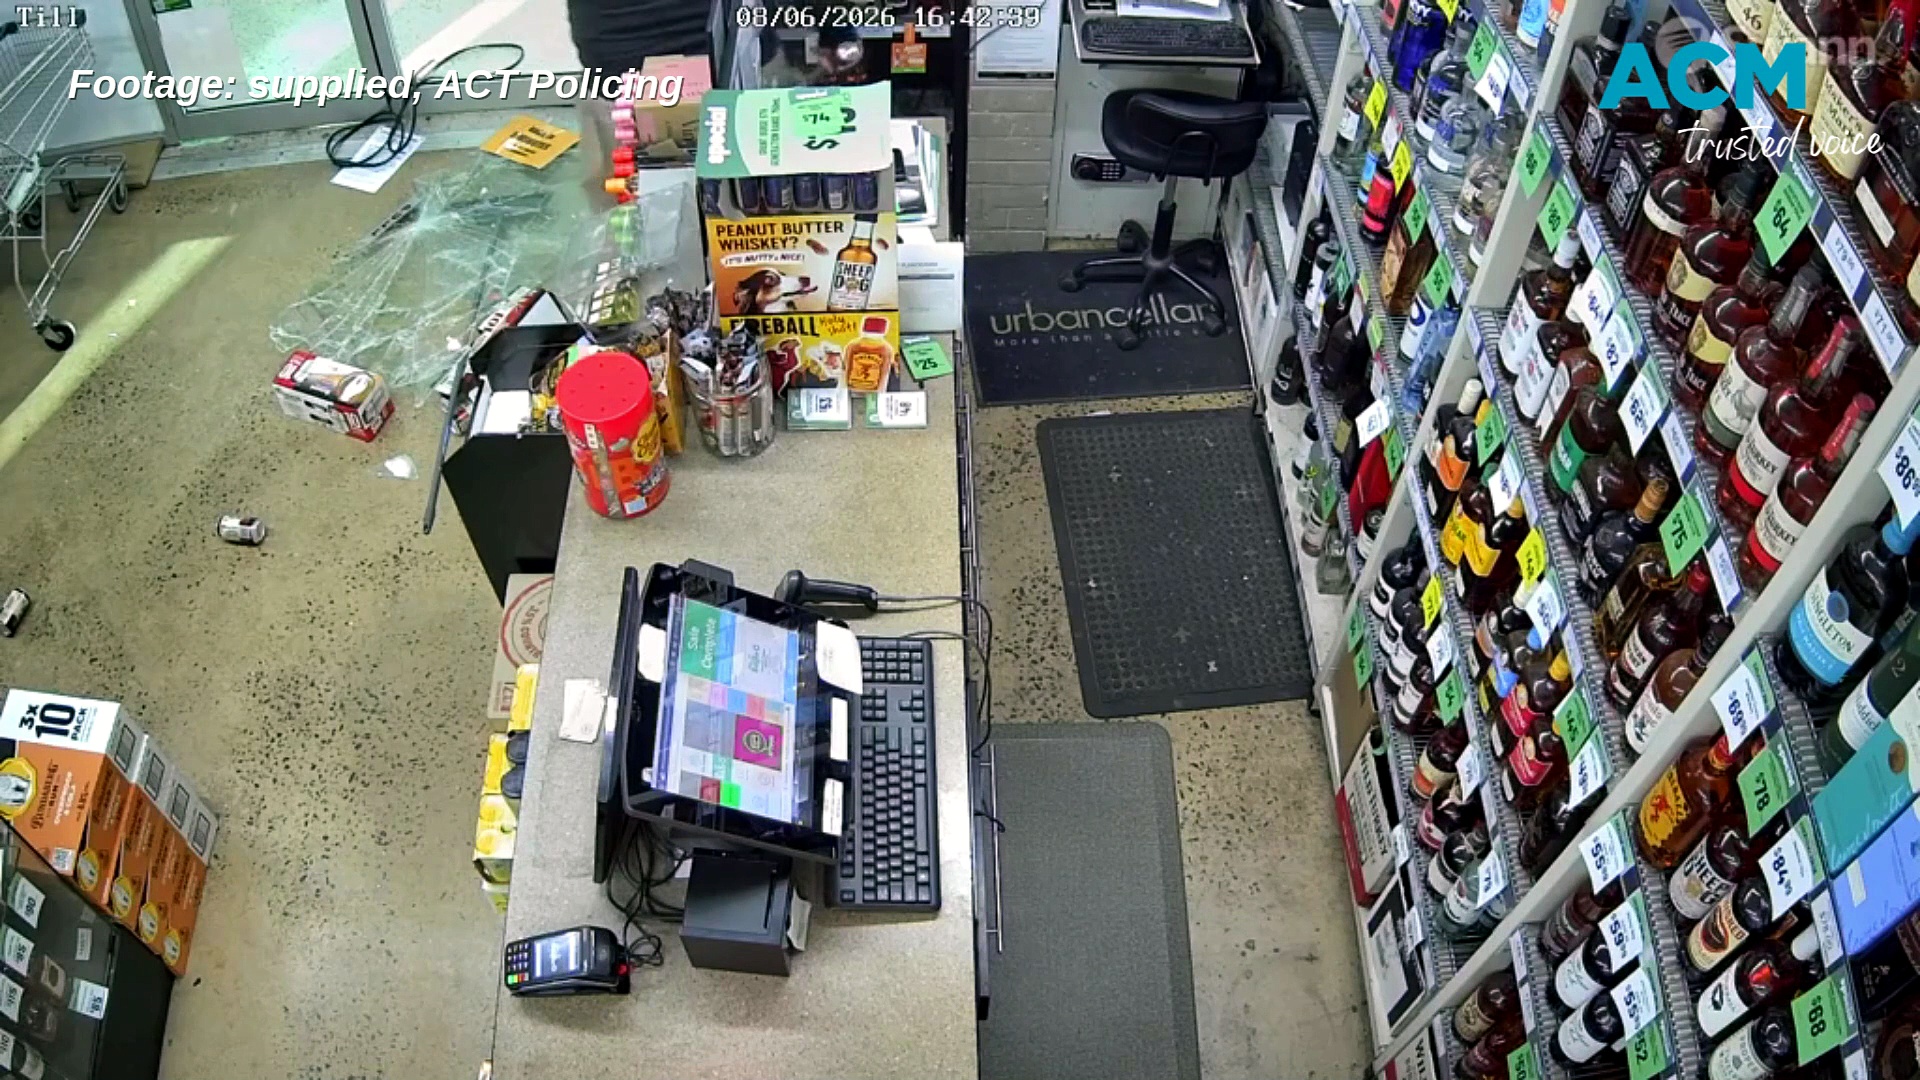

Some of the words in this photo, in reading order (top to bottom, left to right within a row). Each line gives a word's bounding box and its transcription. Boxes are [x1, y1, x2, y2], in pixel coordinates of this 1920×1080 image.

[716, 223, 778, 237] PEANUT
[783, 221, 845, 235] BUTTER
[1772, 198, 1790, 240] $64
[718, 236, 799, 251] WHISKEY?
[837, 262, 874, 277] SHEEP
[913, 357, 939, 371] $25
[1670, 512, 1689, 551] $75
[688, 625, 700, 651] Sale
[701, 617, 718, 670] Complete
[18, 703, 39, 731] 3x
[35, 702, 77, 740] 10
[70, 707, 88, 742] PACK
[1754, 771, 1773, 812] $78
[1808, 995, 1827, 1038] $68
